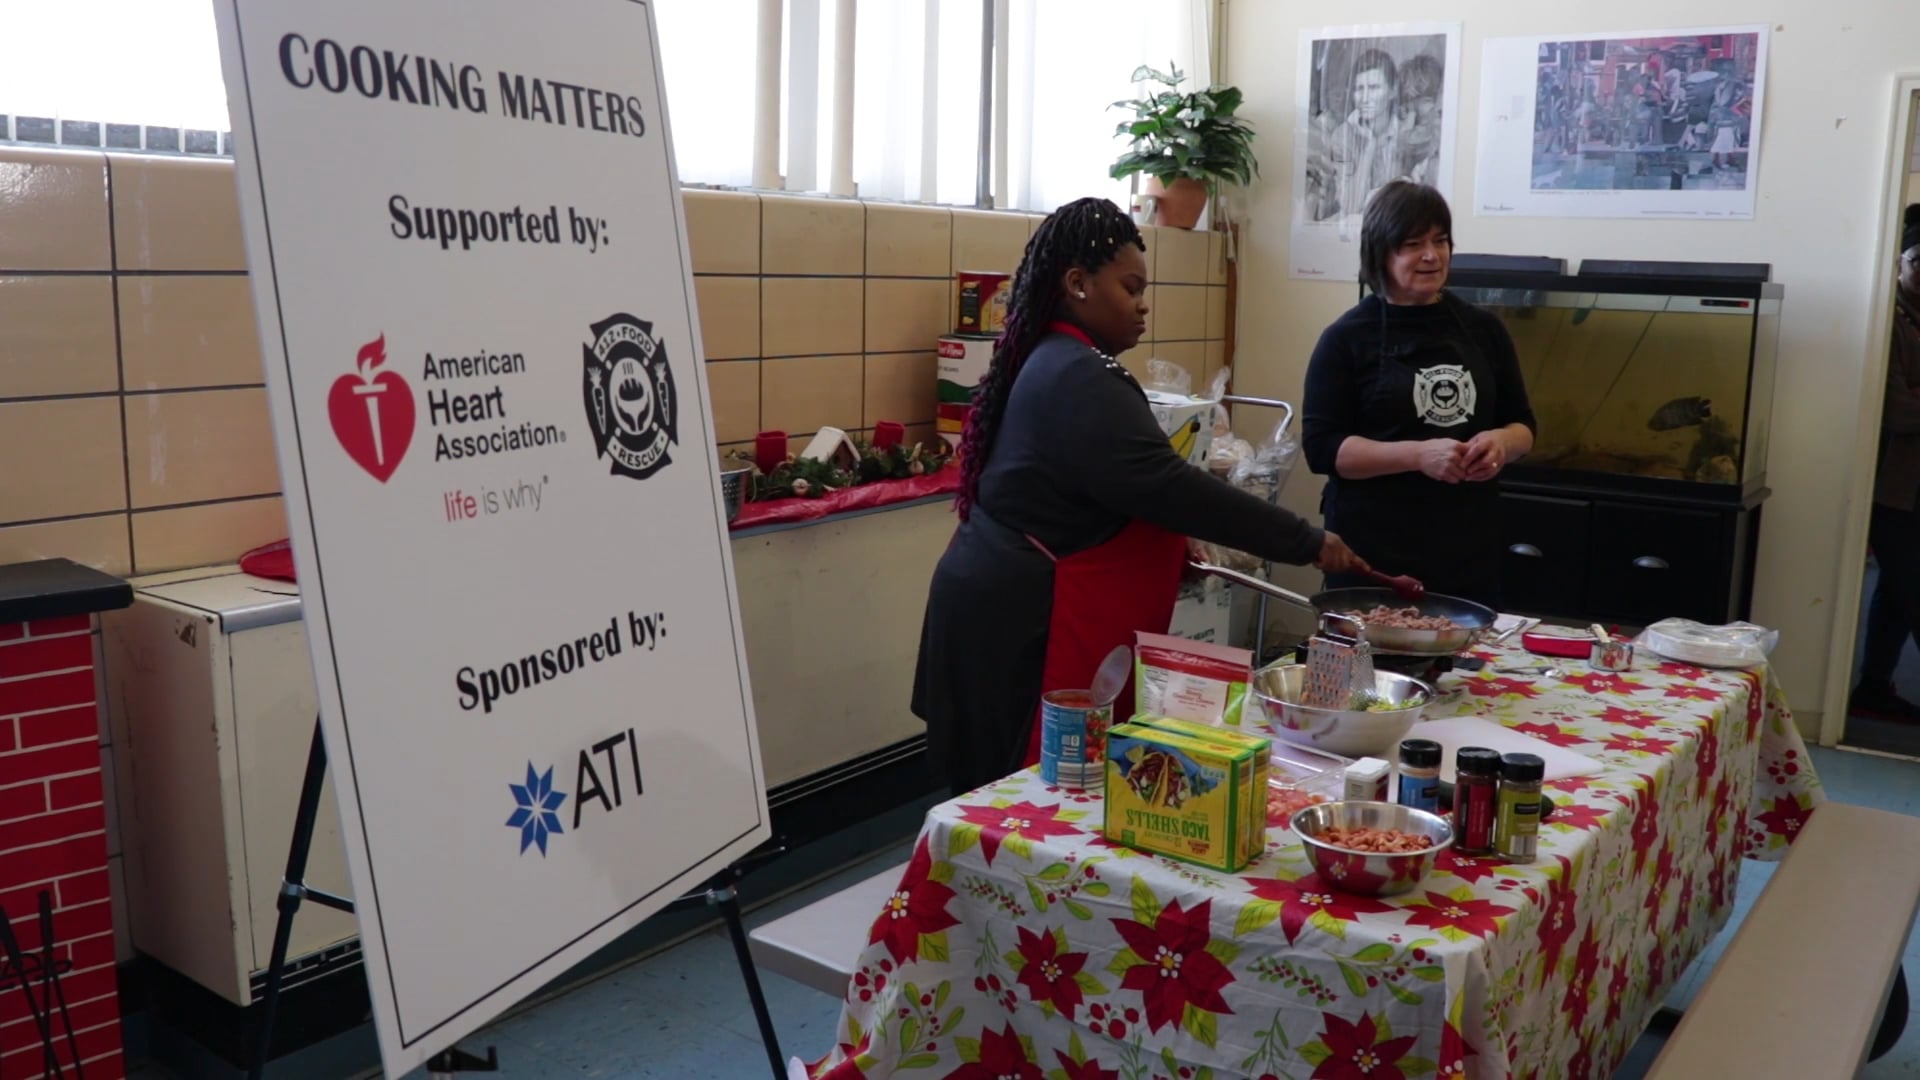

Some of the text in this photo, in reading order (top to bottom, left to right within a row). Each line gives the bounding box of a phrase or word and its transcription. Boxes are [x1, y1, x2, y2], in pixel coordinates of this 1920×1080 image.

[278, 32, 646, 138] COOKING MATTERS
[388, 194, 610, 254] Supported by:
[423, 349, 526, 381] American
[427, 385, 506, 427] Heart
[618, 442, 661, 468] RESCUE
[443, 489, 478, 523] life
[481, 485, 500, 516] is
[455, 610, 667, 714] Sponsored by:
[572, 727, 644, 831] ATI
[1125, 810, 1180, 835] SHELLS
[1181, 820, 1210, 842] TACO
